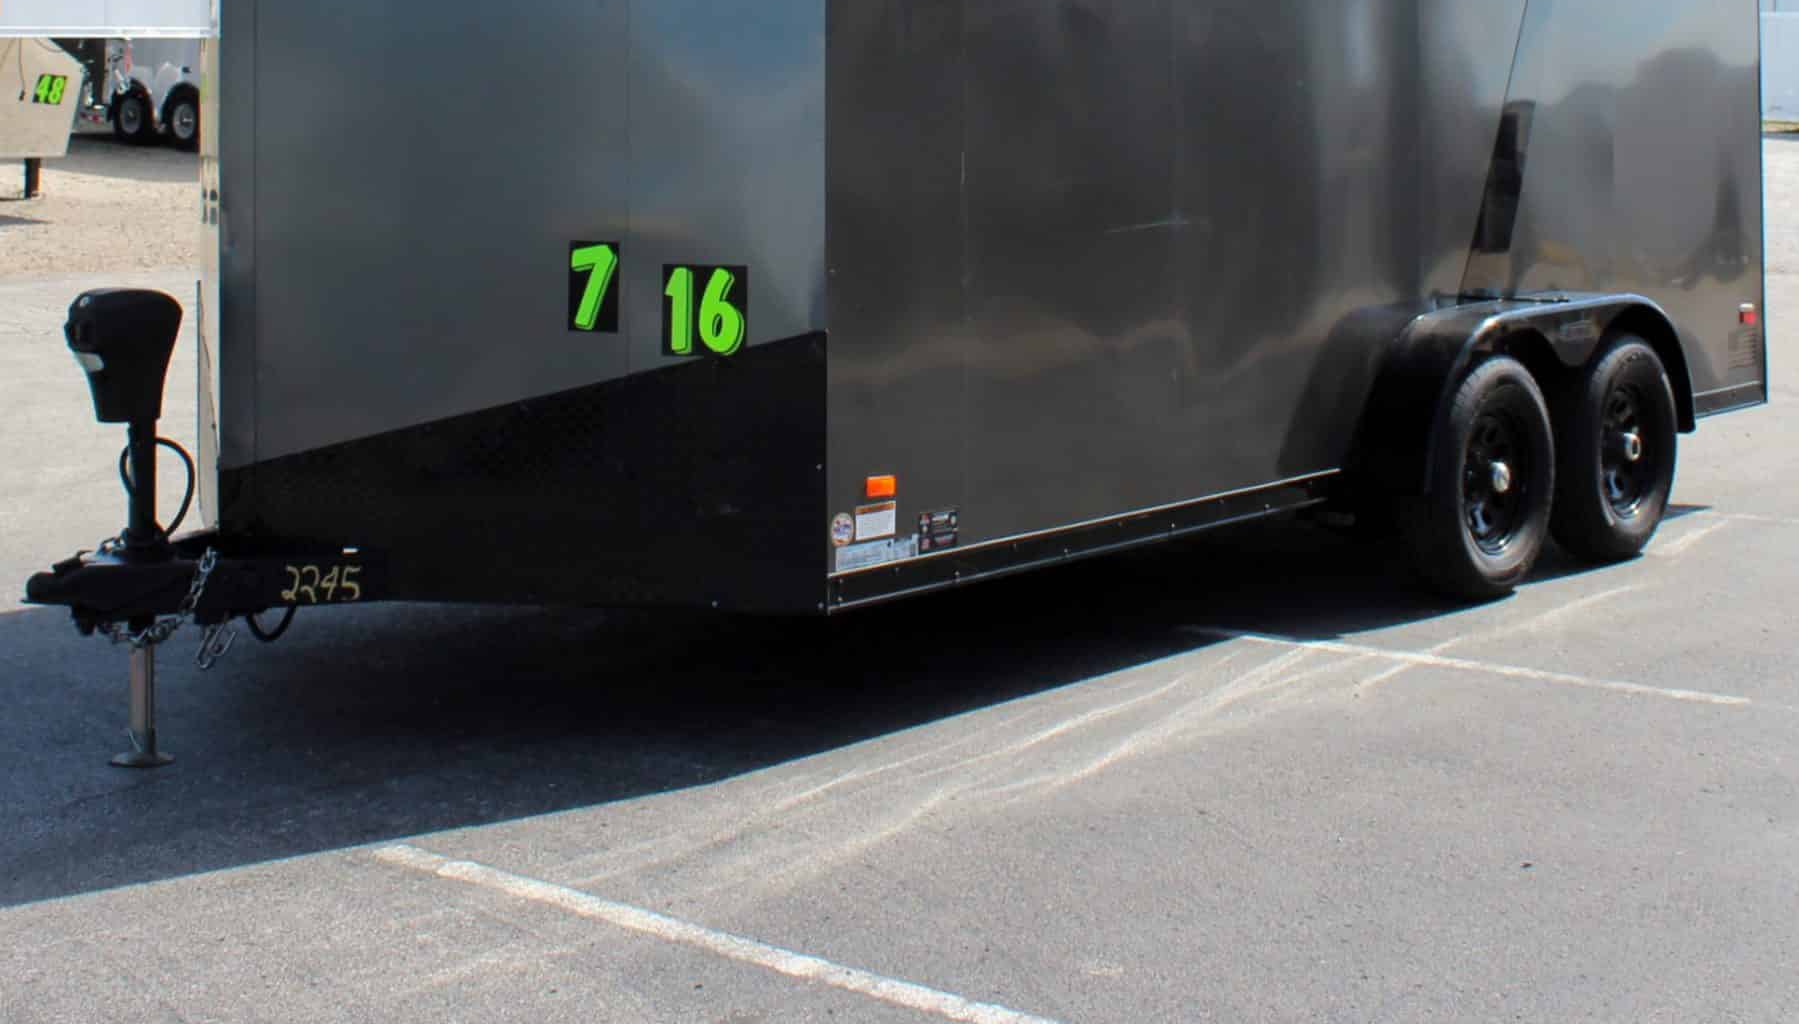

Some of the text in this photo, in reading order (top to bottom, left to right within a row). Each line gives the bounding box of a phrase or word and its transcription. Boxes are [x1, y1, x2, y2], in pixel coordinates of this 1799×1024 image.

[36, 74, 65, 104] 48
[571, 244, 745, 356] 7 16
[281, 565, 361, 603] 2245
